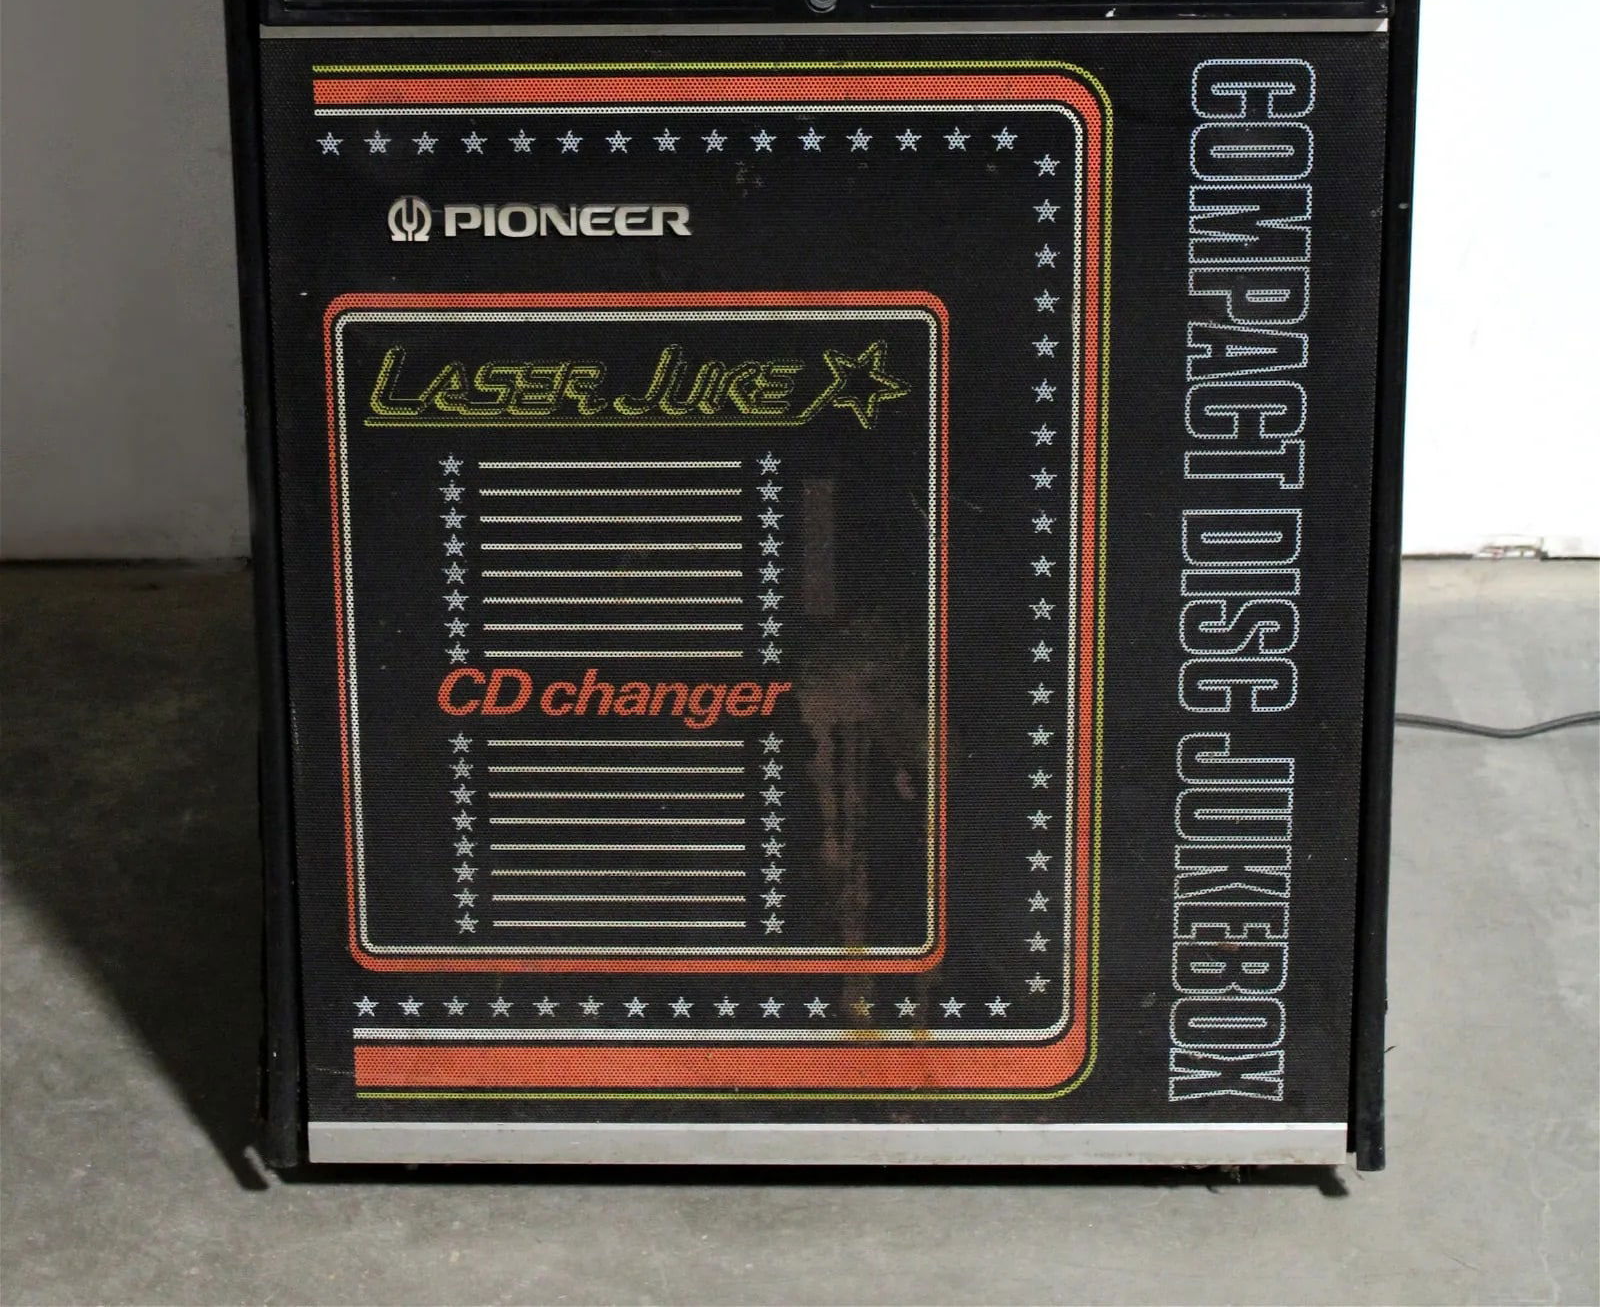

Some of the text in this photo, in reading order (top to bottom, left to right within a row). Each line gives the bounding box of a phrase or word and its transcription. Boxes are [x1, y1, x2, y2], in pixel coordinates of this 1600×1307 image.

[443, 202, 693, 238] PIONEER
[1168, 58, 1316, 1102] COMPACT DISC JUKEBOX
[437, 668, 793, 729] CD changer
